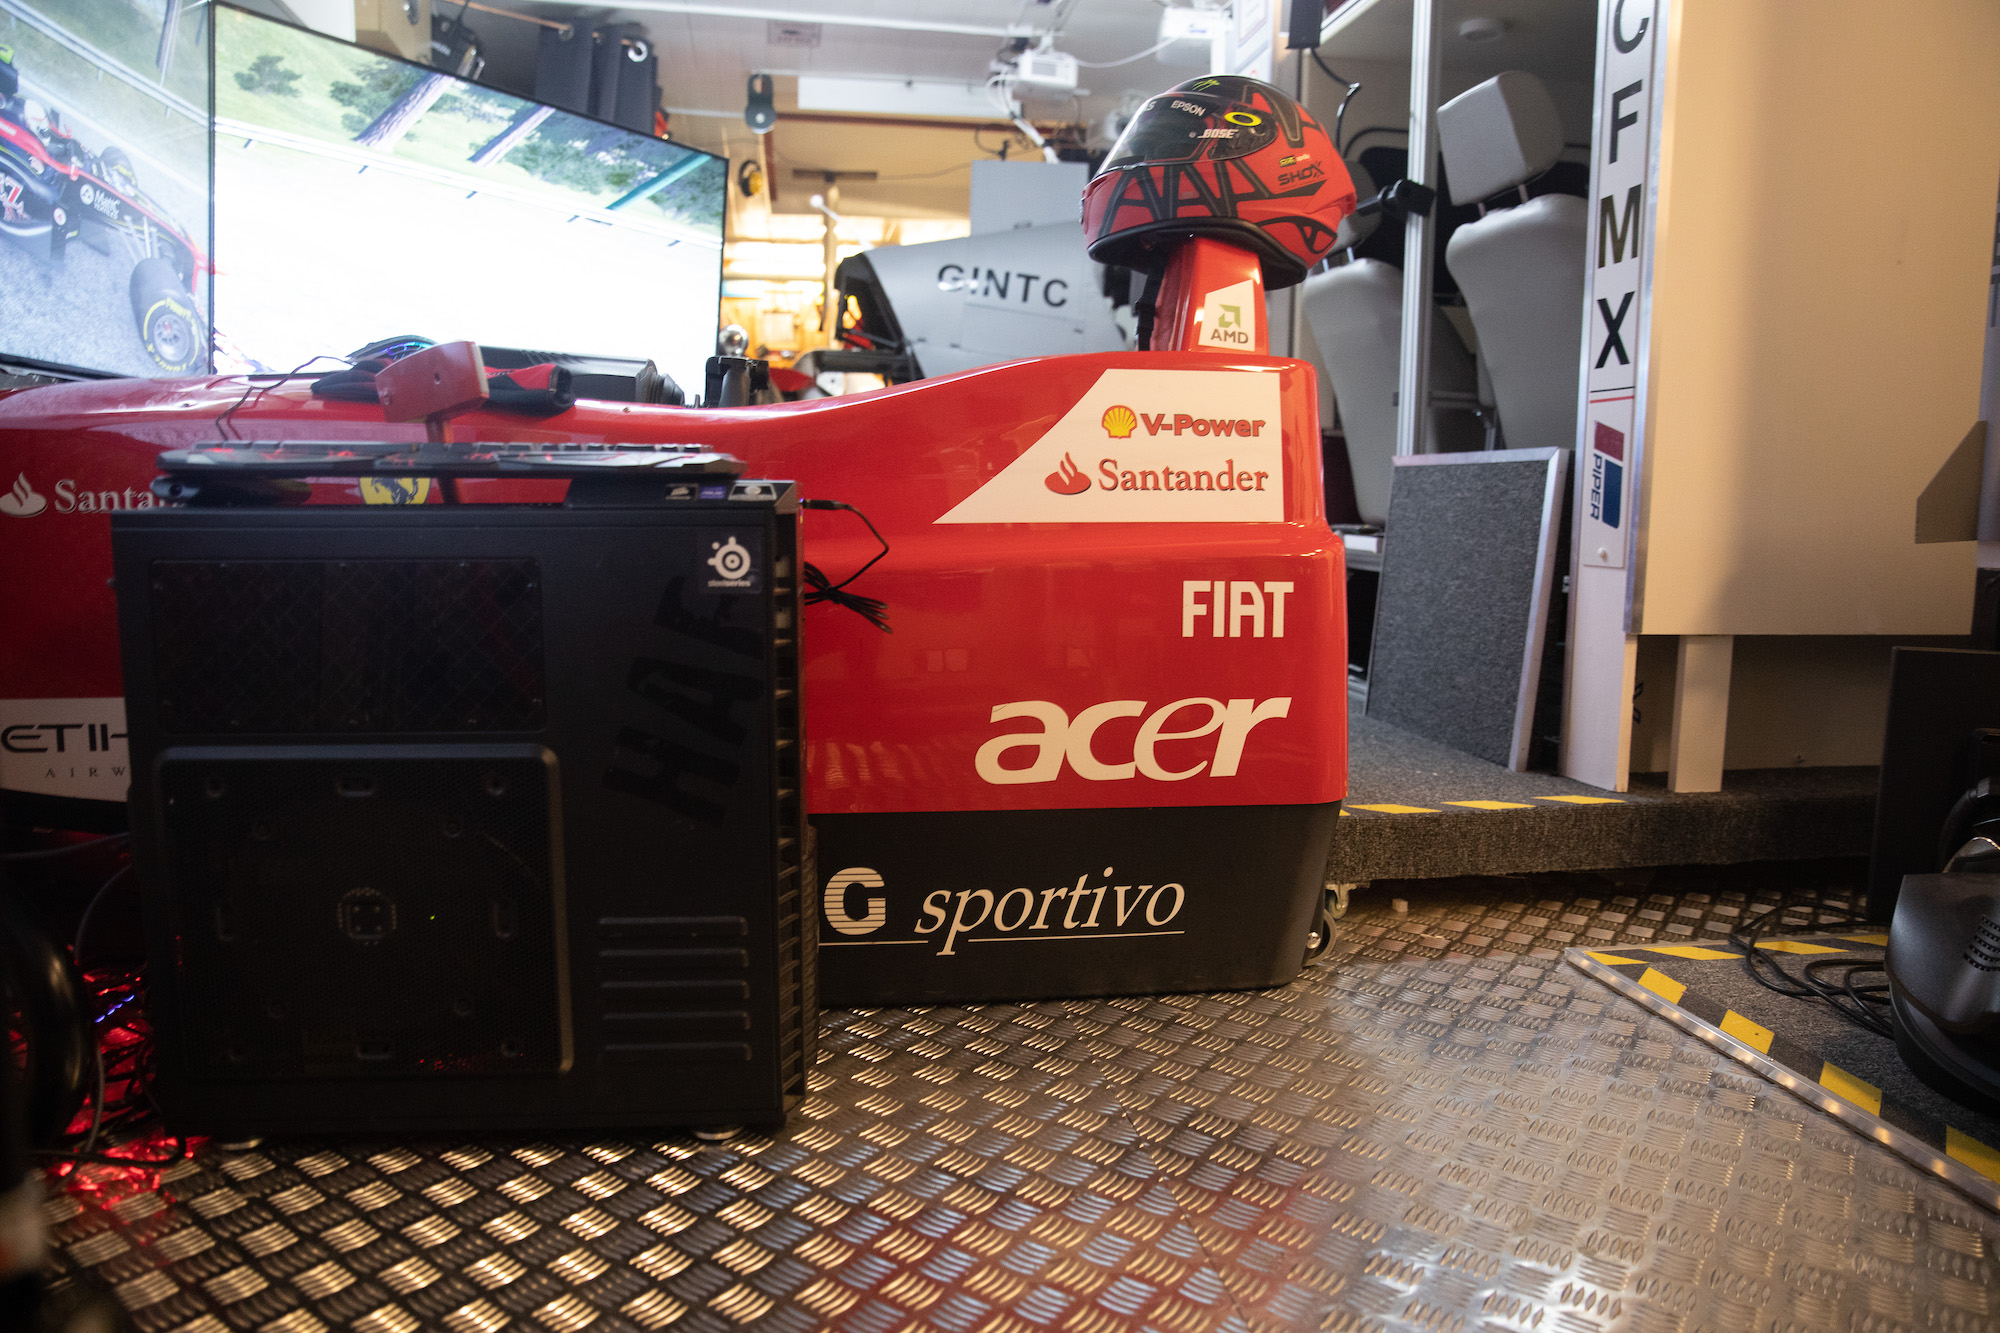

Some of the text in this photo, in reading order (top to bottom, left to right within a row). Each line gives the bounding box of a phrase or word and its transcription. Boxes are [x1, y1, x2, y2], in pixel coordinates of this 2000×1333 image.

[1170, 100, 1206, 117] EPSON
[1198, 128, 1240, 139] BOSE
[937, 263, 1069, 308] GINTC
[1210, 328, 1249, 344] AMD
[1140, 413, 1267, 438] V-Power
[1098, 457, 1270, 492] Santander
[1590, 453, 1603, 521] PIPER
[1182, 580, 1294, 638] FIAT
[600, 575, 767, 828] HAF
[974, 696, 1292, 785] acer
[914, 866, 1185, 957] sportivo
